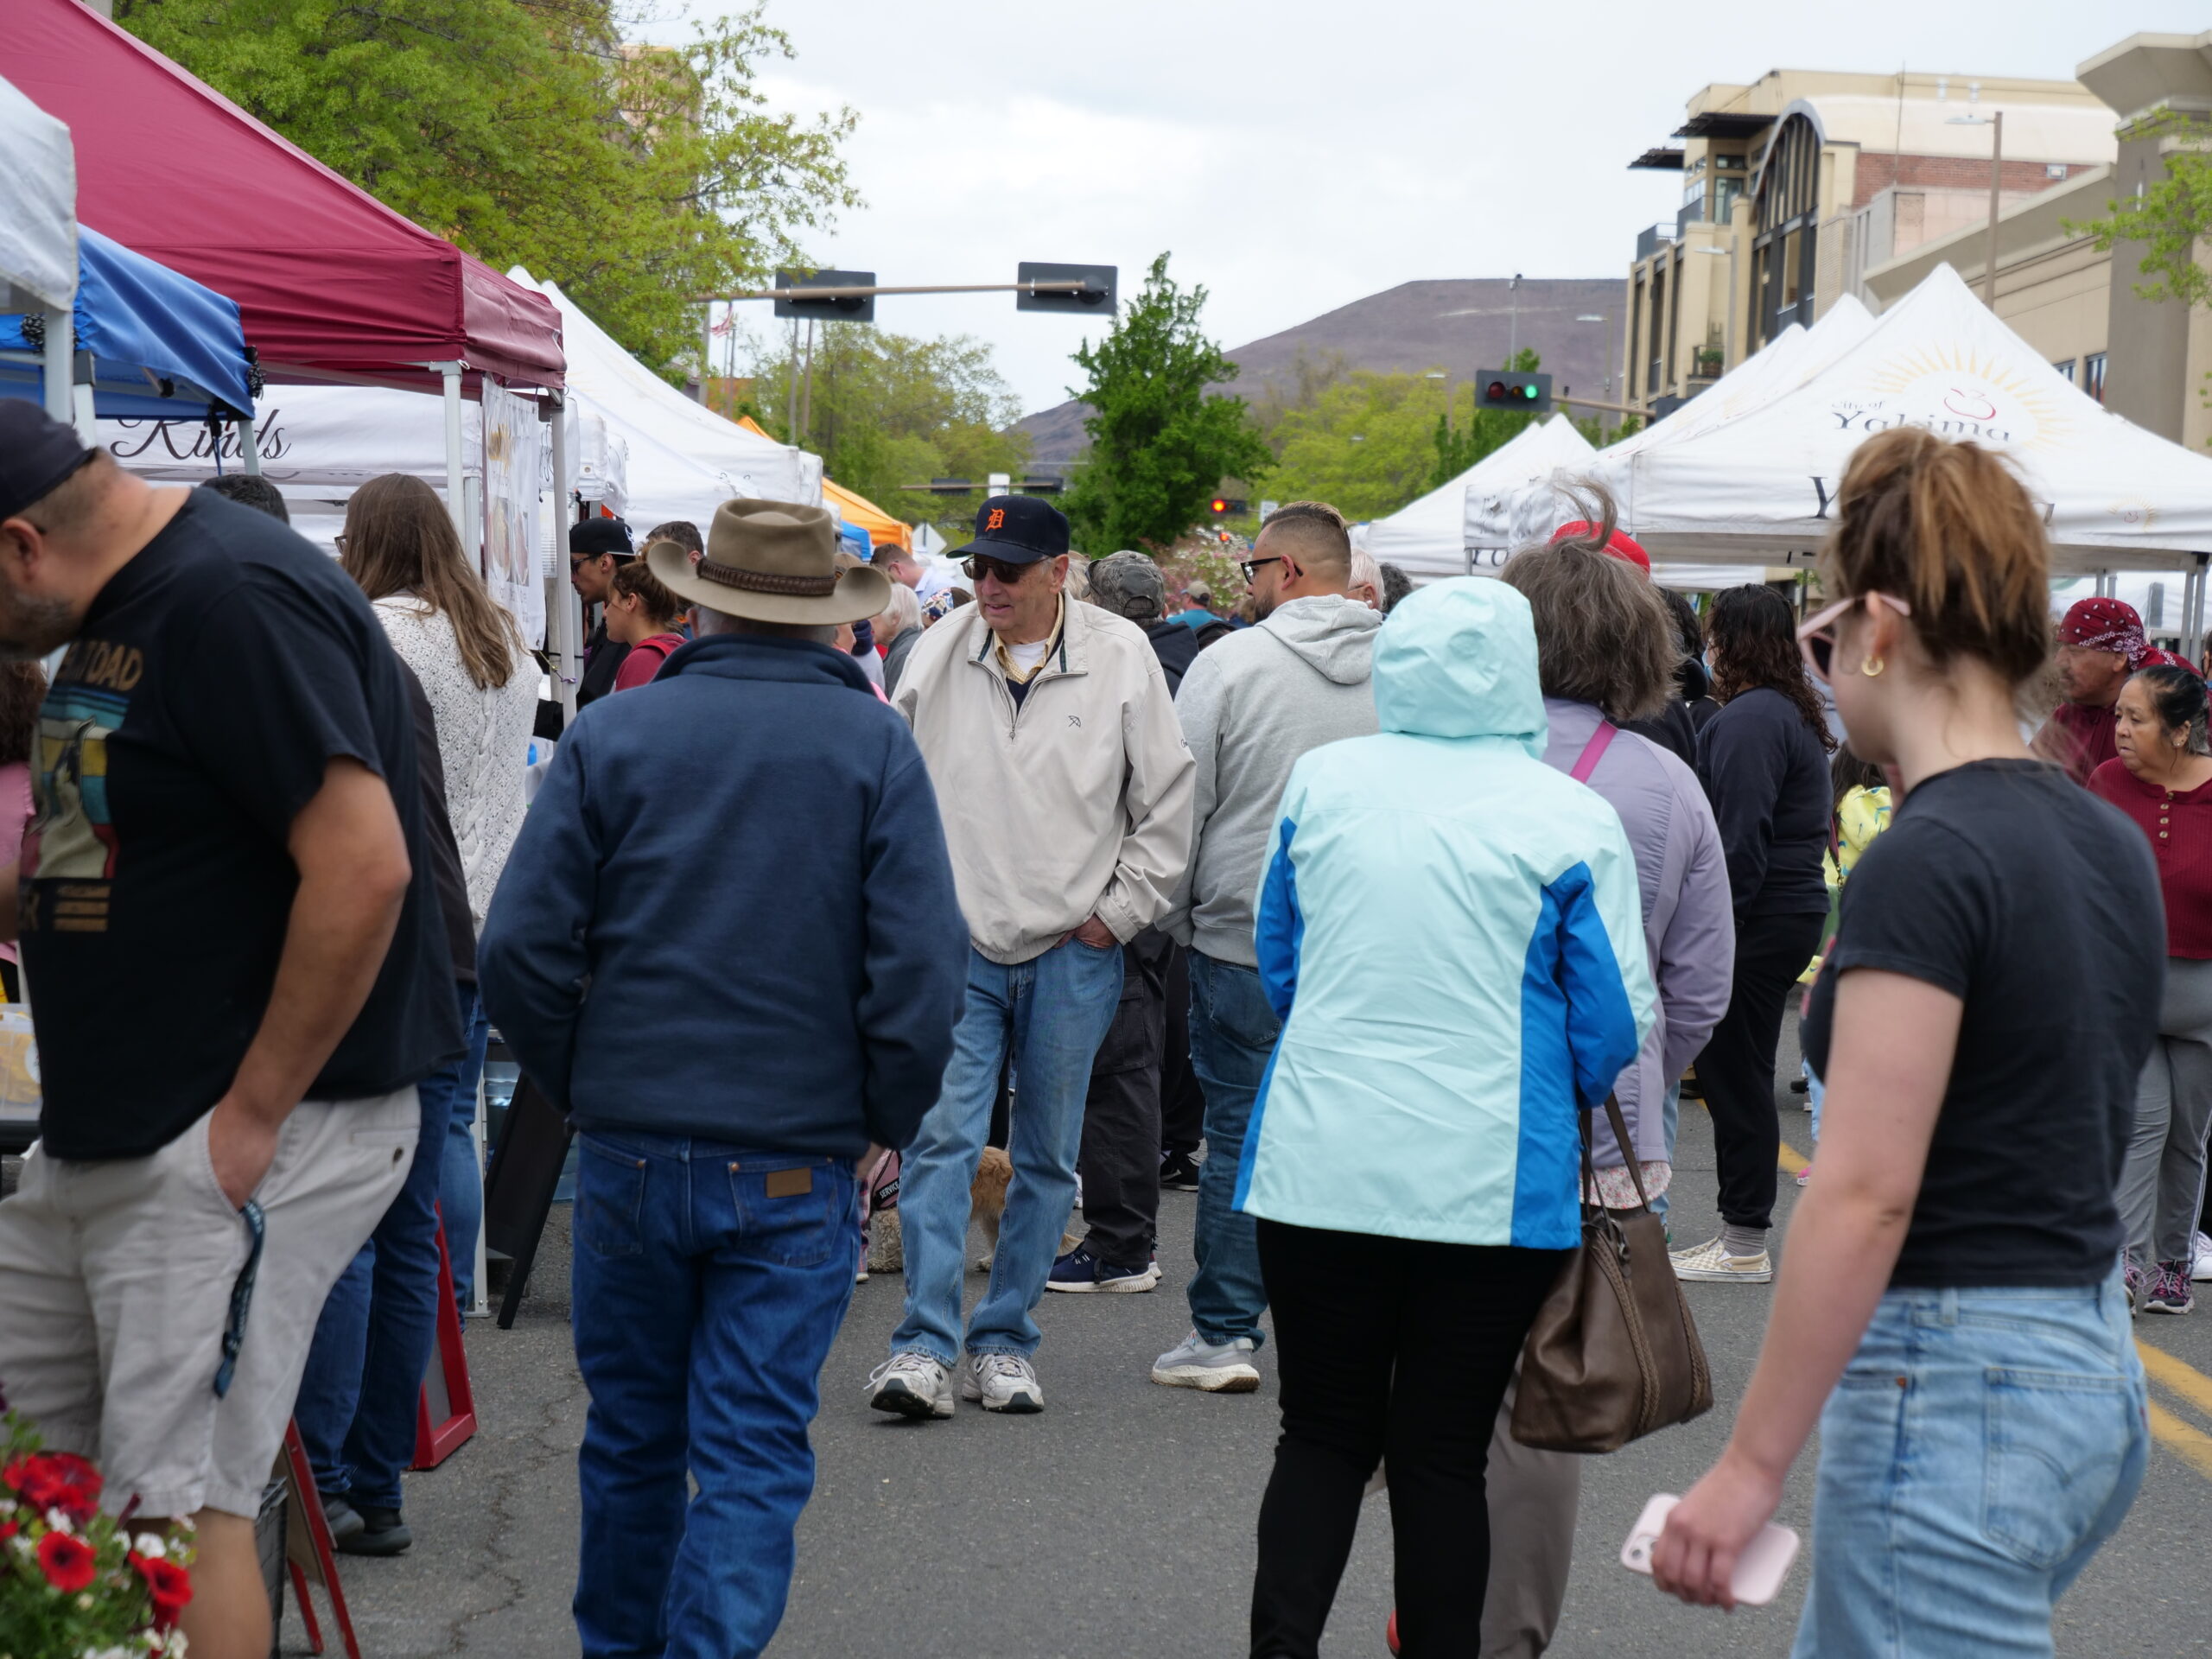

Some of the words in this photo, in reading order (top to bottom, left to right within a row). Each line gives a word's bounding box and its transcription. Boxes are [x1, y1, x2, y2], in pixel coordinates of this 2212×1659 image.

[1868, 400, 1885, 410] of
[984, 508, 1005, 532] D
[880, 1181, 899, 1198] SERVICE
[935, 1370, 944, 1383] N
